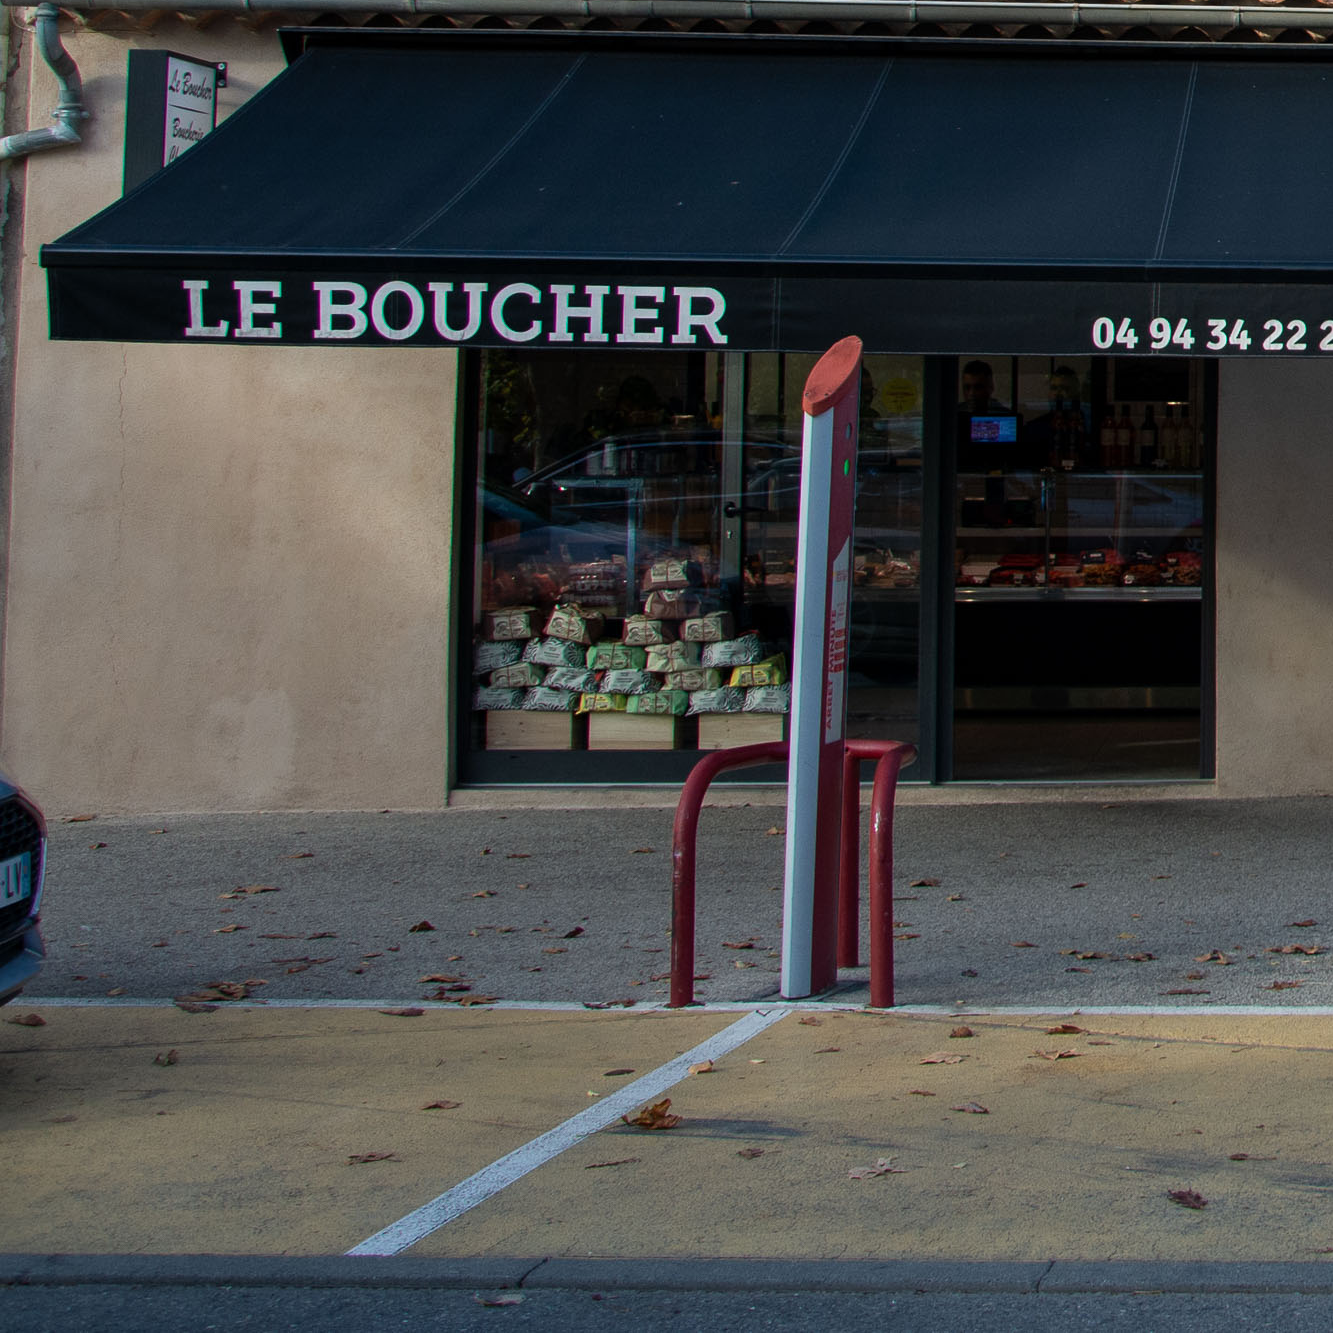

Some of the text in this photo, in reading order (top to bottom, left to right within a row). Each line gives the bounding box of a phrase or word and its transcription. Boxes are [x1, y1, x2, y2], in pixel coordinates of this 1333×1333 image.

[168, 68, 213, 101] Le Boucher
[182, 279, 729, 345] LE BOUCHER
[1091, 316, 1139, 350] 04
[1149, 317, 1196, 350] 94
[1205, 318, 1252, 352] 34
[1261, 319, 1308, 352] 22
